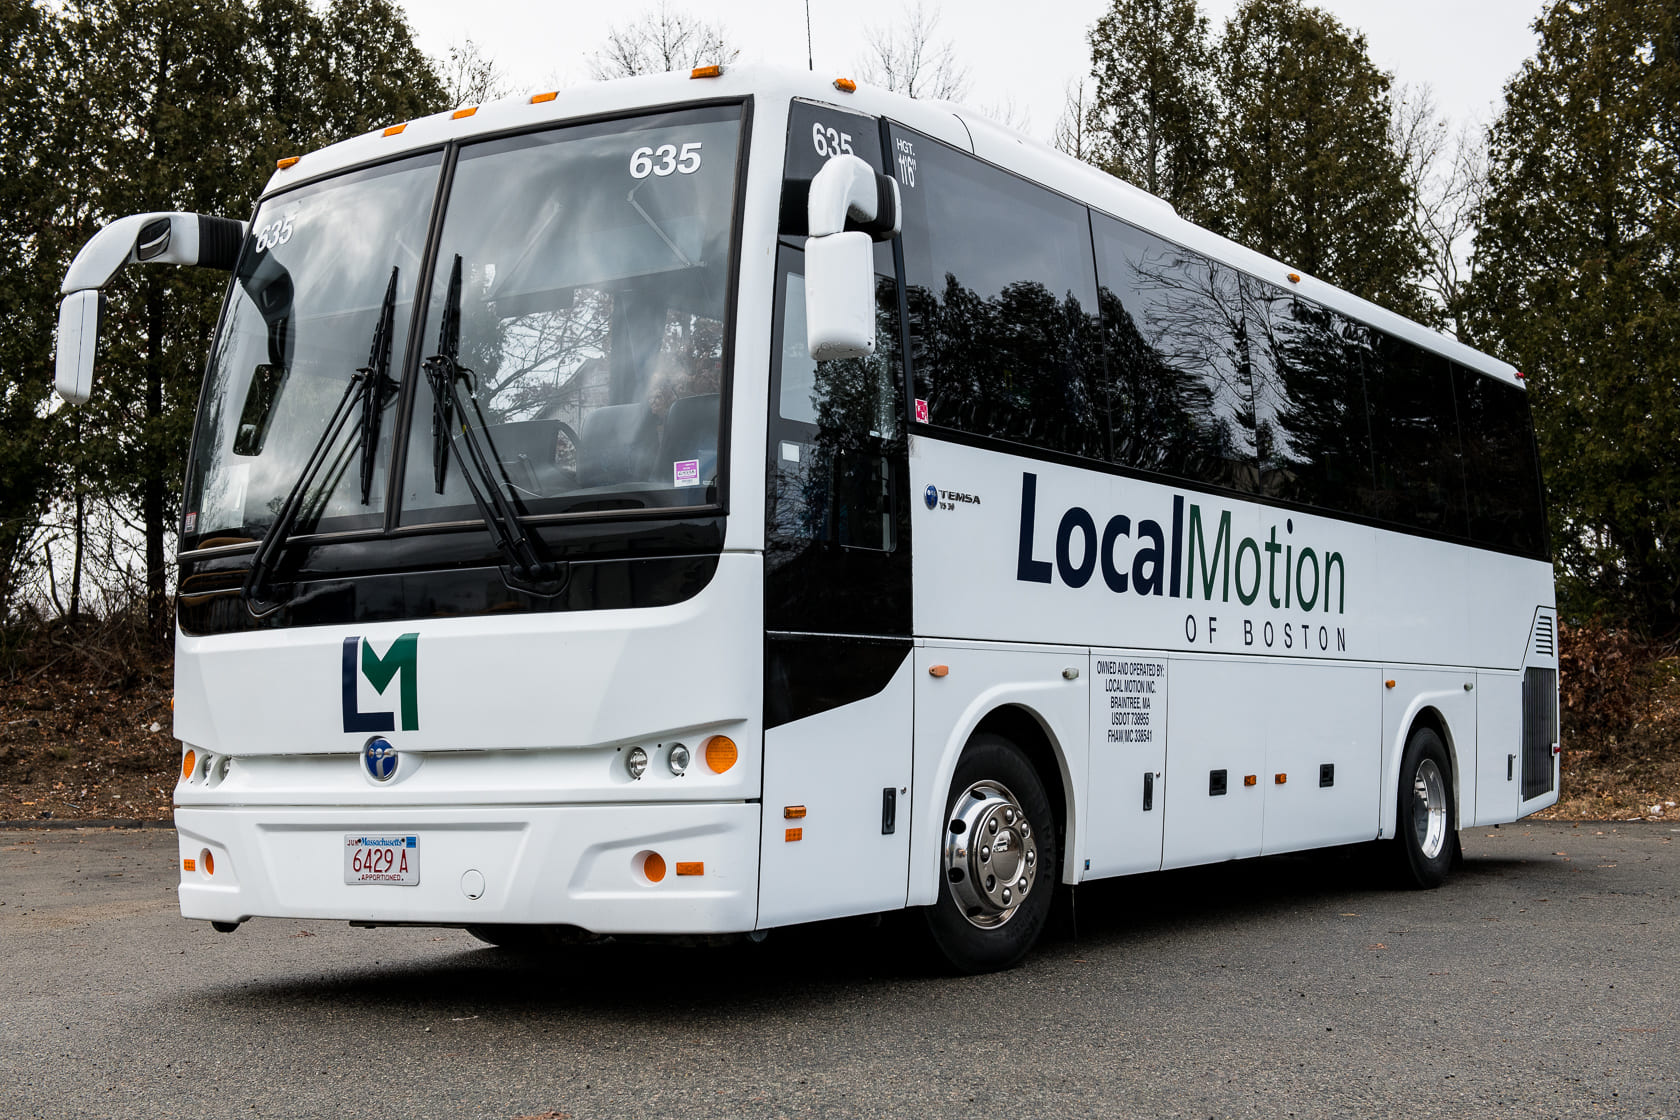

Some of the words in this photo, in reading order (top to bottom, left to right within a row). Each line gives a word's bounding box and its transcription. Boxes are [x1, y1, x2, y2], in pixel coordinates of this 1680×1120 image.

[812, 122, 855, 158] 635
[896, 137, 916, 156] HGT.
[629, 142, 702, 179] 635
[255, 215, 296, 253] 635
[938, 489, 981, 505] TEMSA
[1185, 614, 1217, 644] OF
[1243, 619, 1346, 652] BOSTON
[1096, 660, 1117, 675] OWNED
[1117, 662, 1129, 676] AND
[1129, 662, 1156, 677] OPERATED
[1156, 664, 1165, 678] BY:
[342, 632, 420, 733] LM
[1105, 678, 1123, 693] LOCAL
[1124, 679, 1145, 694] MOTION
[1145, 680, 1157, 694] INC.
[1110, 696, 1141, 711] BRAINTREE,
[1142, 697, 1151, 710] MA
[1111, 711, 1130, 726] USDOT
[361, 837, 402, 847] Massachusetts
[353, 848, 394, 873] 6429
[400, 848, 408, 873] A
[361, 873, 401, 881] APPORTIONED
